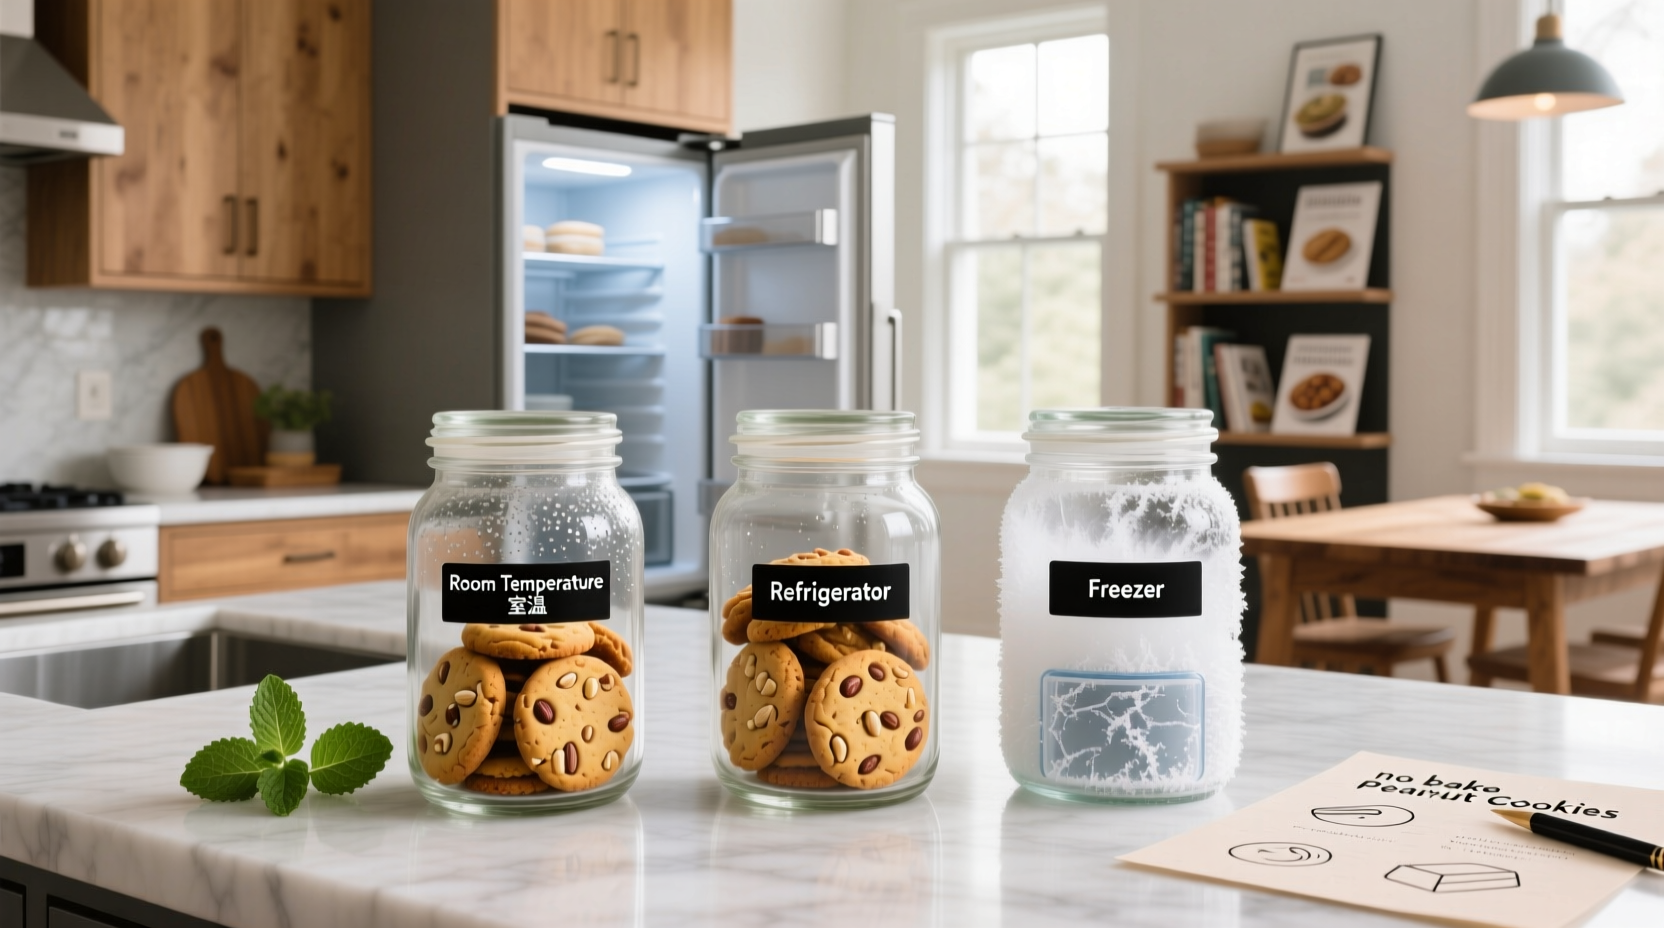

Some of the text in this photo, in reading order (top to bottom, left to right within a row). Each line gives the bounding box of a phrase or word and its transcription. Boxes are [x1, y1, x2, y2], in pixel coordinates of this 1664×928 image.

[450, 574, 604, 596] Room Temperature
[770, 581, 892, 607] Refrigerator
[1089, 578, 1165, 599] Freezer
[508, 595, 548, 615] 室温
[1375, 771, 1414, 783] no
[1487, 795, 1619, 819] Cookies
